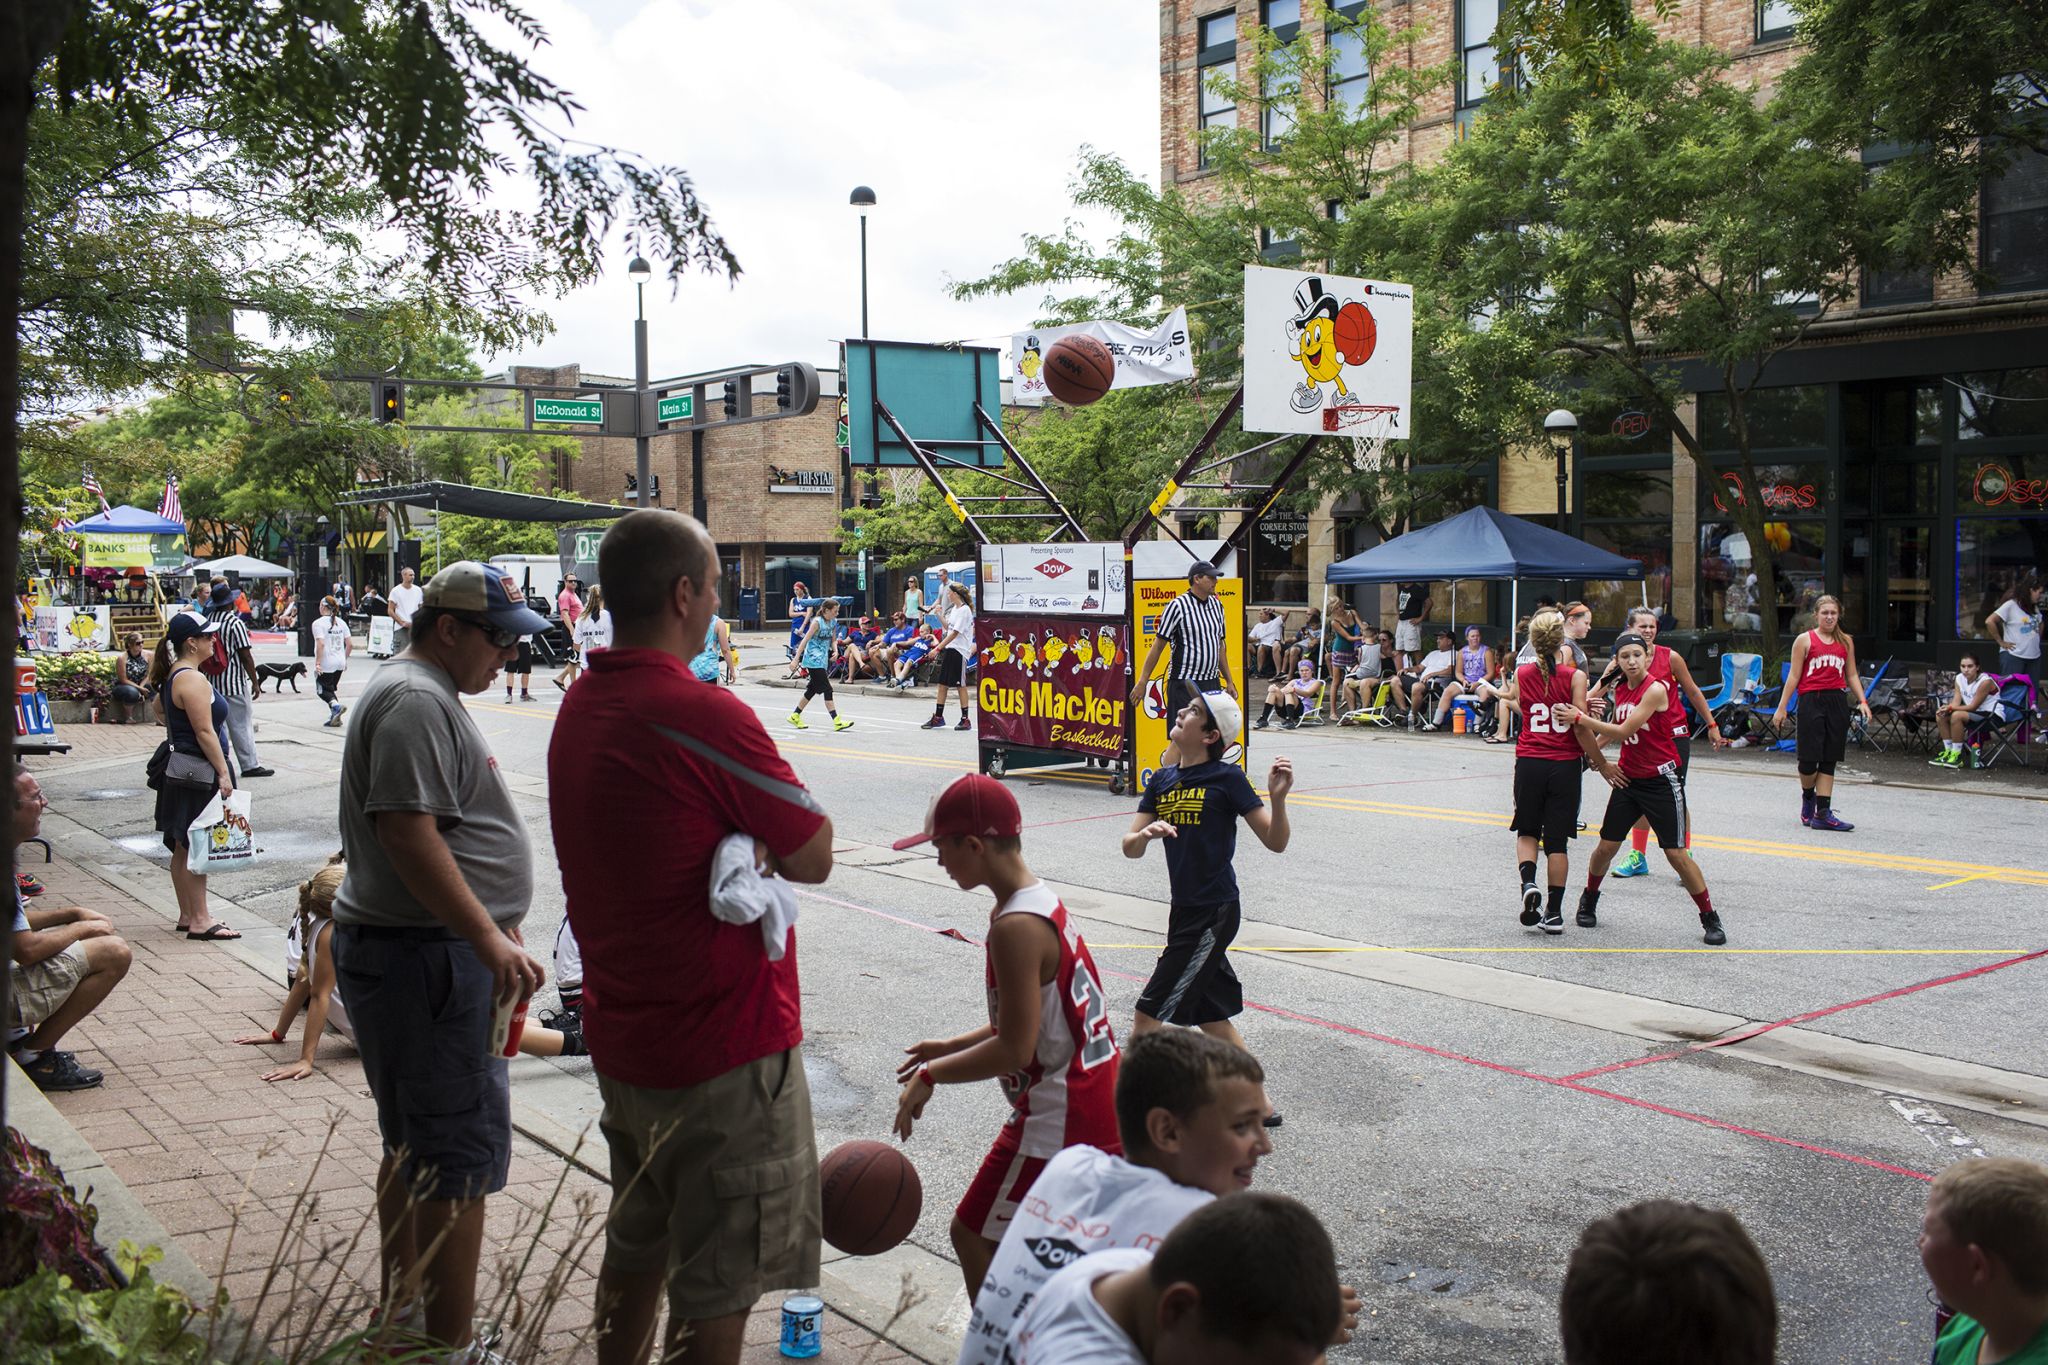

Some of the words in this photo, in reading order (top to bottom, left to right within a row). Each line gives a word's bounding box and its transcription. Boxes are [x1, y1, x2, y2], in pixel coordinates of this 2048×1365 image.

[537, 404, 587, 417] McDonald
[591, 408, 600, 418] St
[662, 404, 680, 416] Main
[681, 401, 689, 412] St
[1611, 415, 1651, 436] OPEN
[1260, 522, 1288, 531] CORNER
[1278, 533, 1293, 542] PUB
[88, 543, 126, 553] BANKS
[1030, 546, 1053, 556] Presenting
[1054, 546, 1074, 555] Sponsors
[1140, 587, 1177, 600] Wilson
[979, 677, 1025, 716] Gus
[1030, 680, 1125, 728] Macker
[1050, 724, 1122, 751] Basketball
